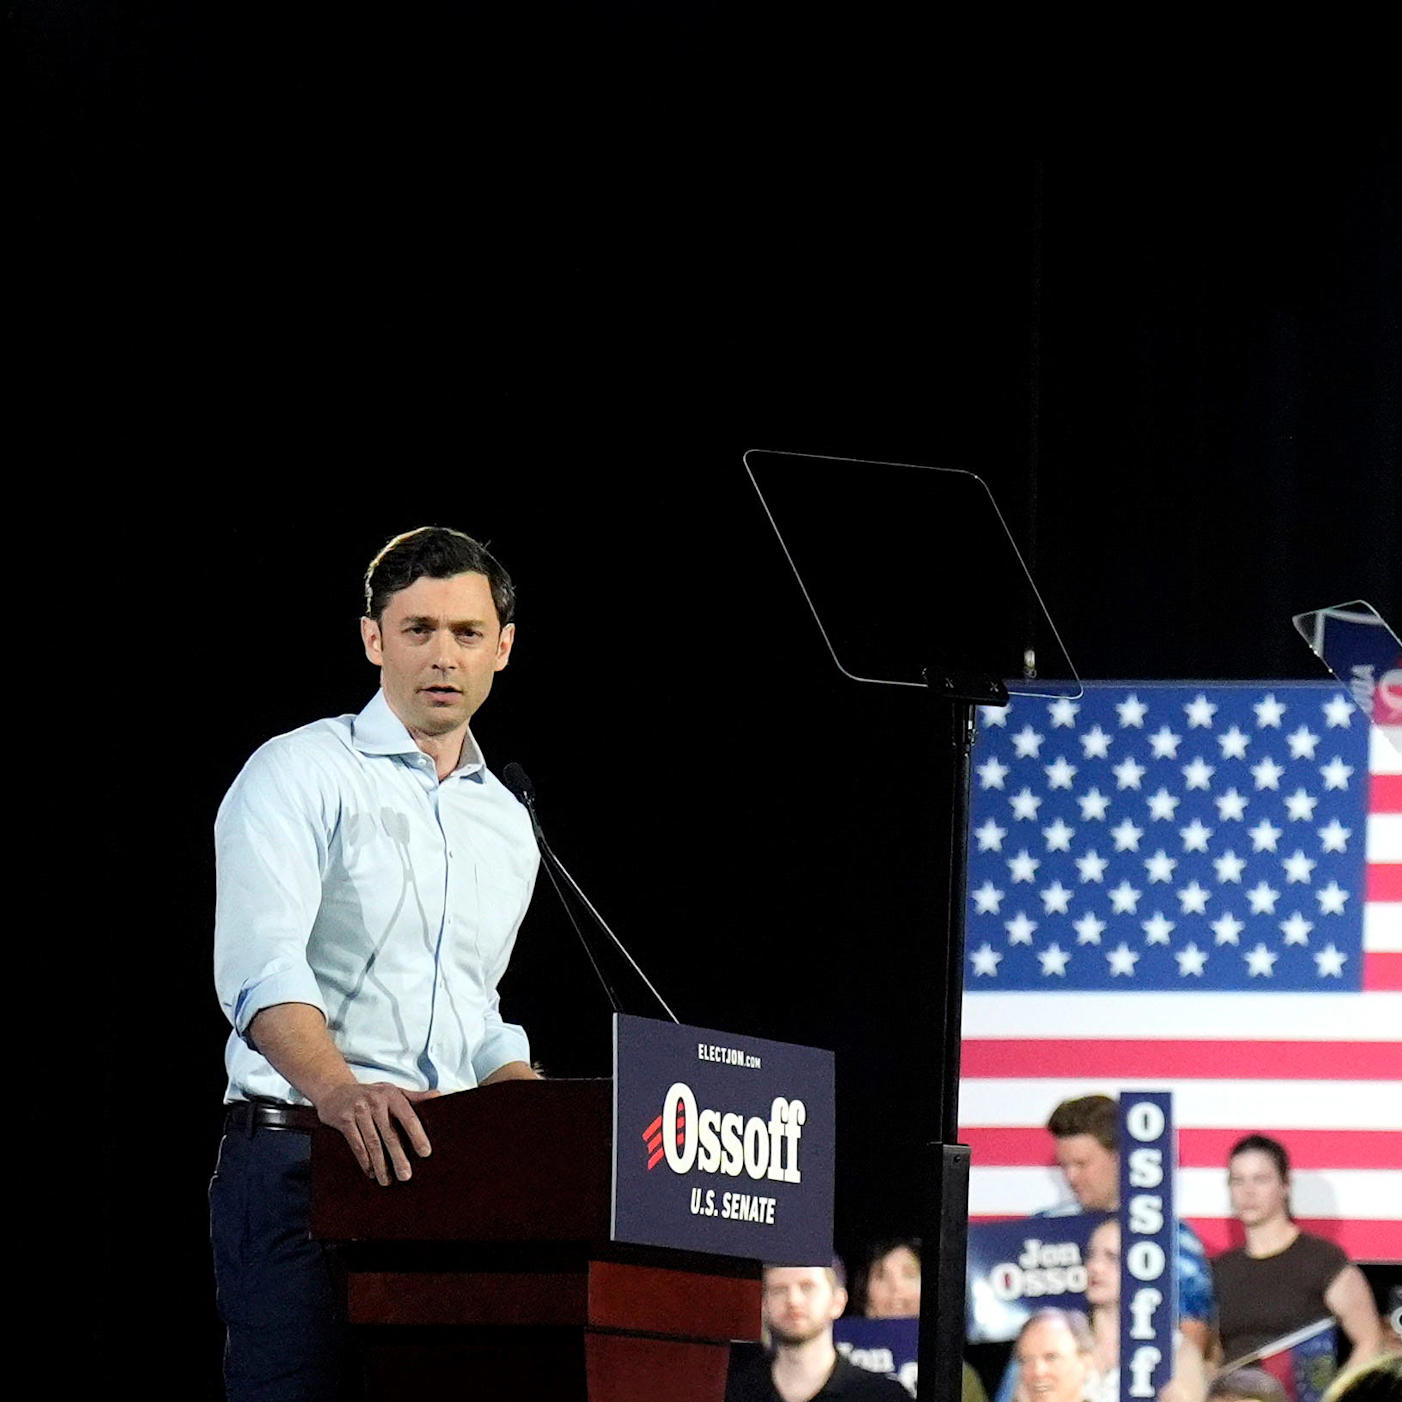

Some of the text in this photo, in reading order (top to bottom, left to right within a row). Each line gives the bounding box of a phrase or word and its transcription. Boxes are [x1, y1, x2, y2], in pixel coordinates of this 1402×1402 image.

[698, 1043, 762, 1069] ELECTJON.COM
[662, 1082, 807, 1184] Ossoff
[690, 1188, 777, 1225] U.S. SENATE
[1019, 1239, 1082, 1269] Jon
[990, 1262, 1088, 1300] Osso
